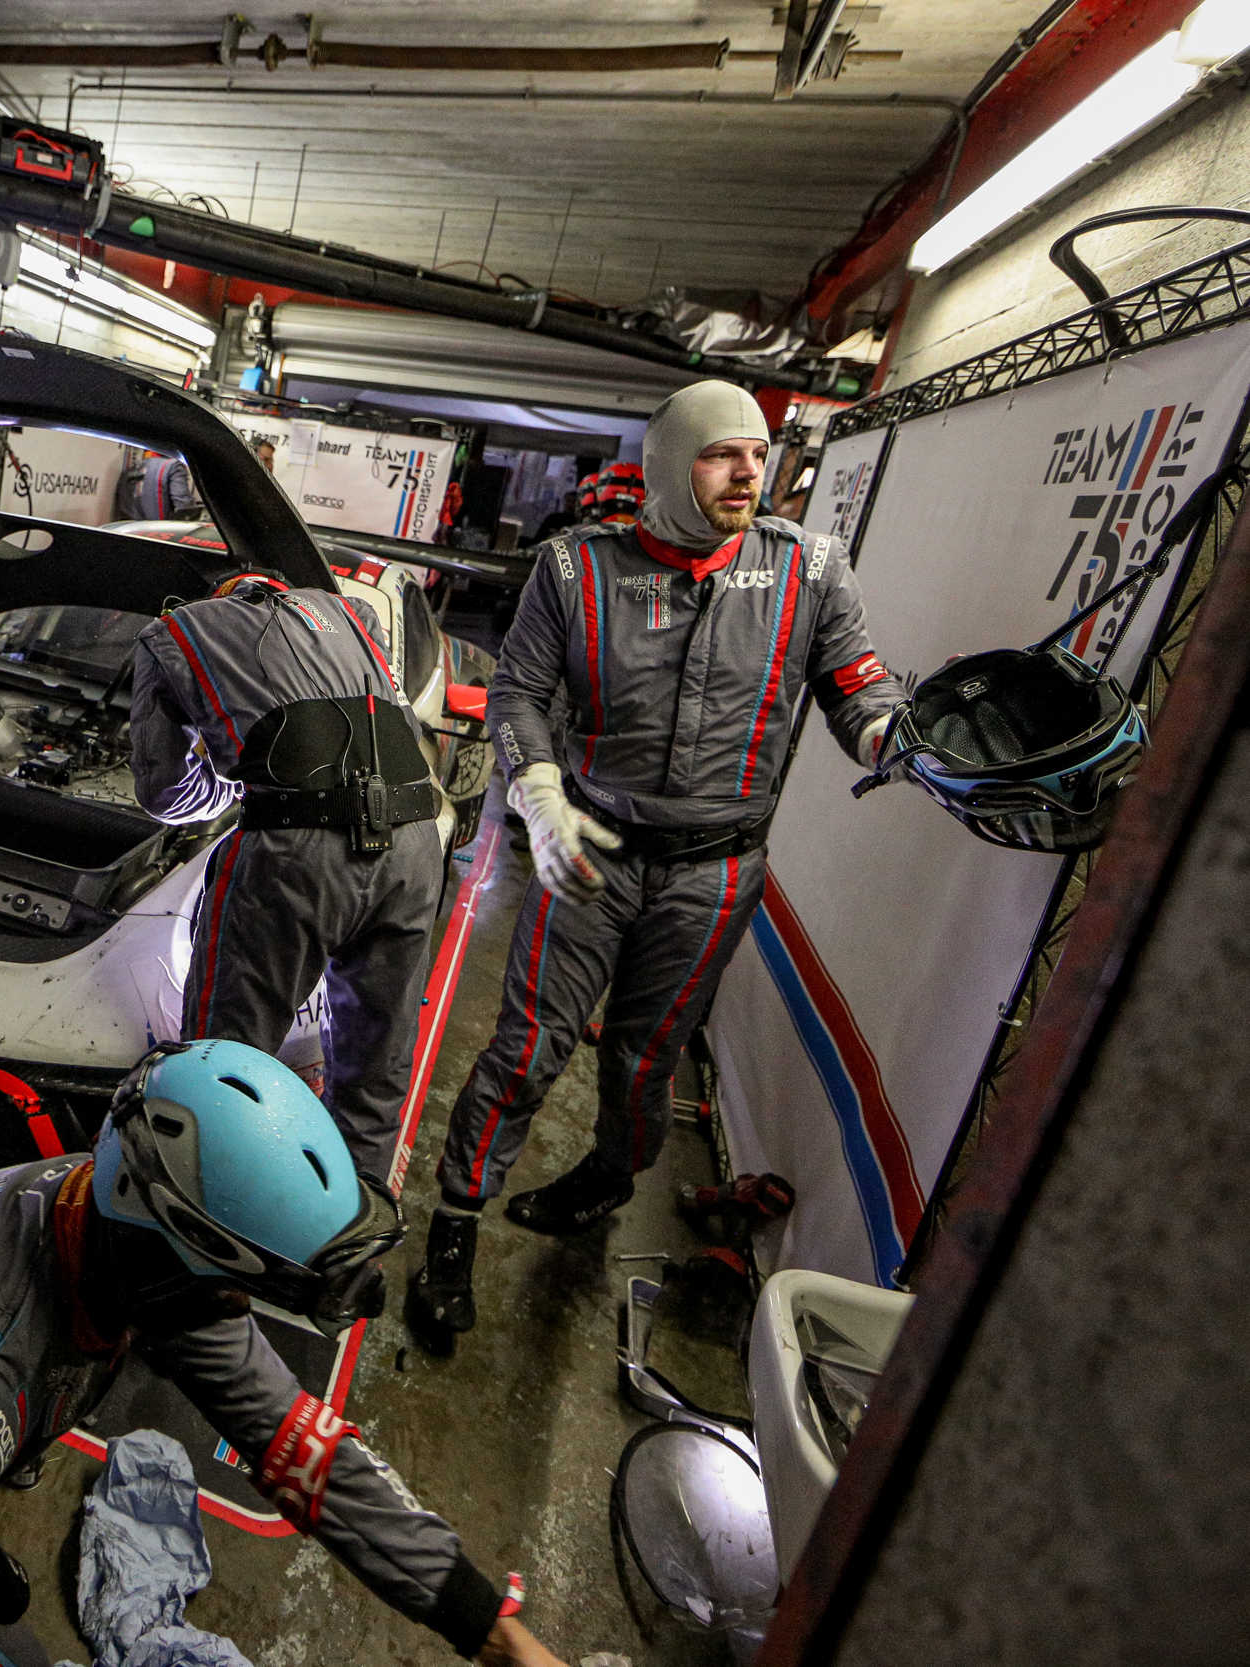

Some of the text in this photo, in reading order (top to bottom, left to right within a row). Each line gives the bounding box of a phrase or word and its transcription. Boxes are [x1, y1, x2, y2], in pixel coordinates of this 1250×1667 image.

[366, 445, 408, 464] TEAM
[1043, 418, 1136, 485] TEAM
[35, 472, 99, 496] URSAPHARM
[387, 464, 419, 492] 75
[302, 494, 345, 509] sparco
[412, 452, 438, 540] MOTORSPORT
[1046, 493, 1142, 612] 75
